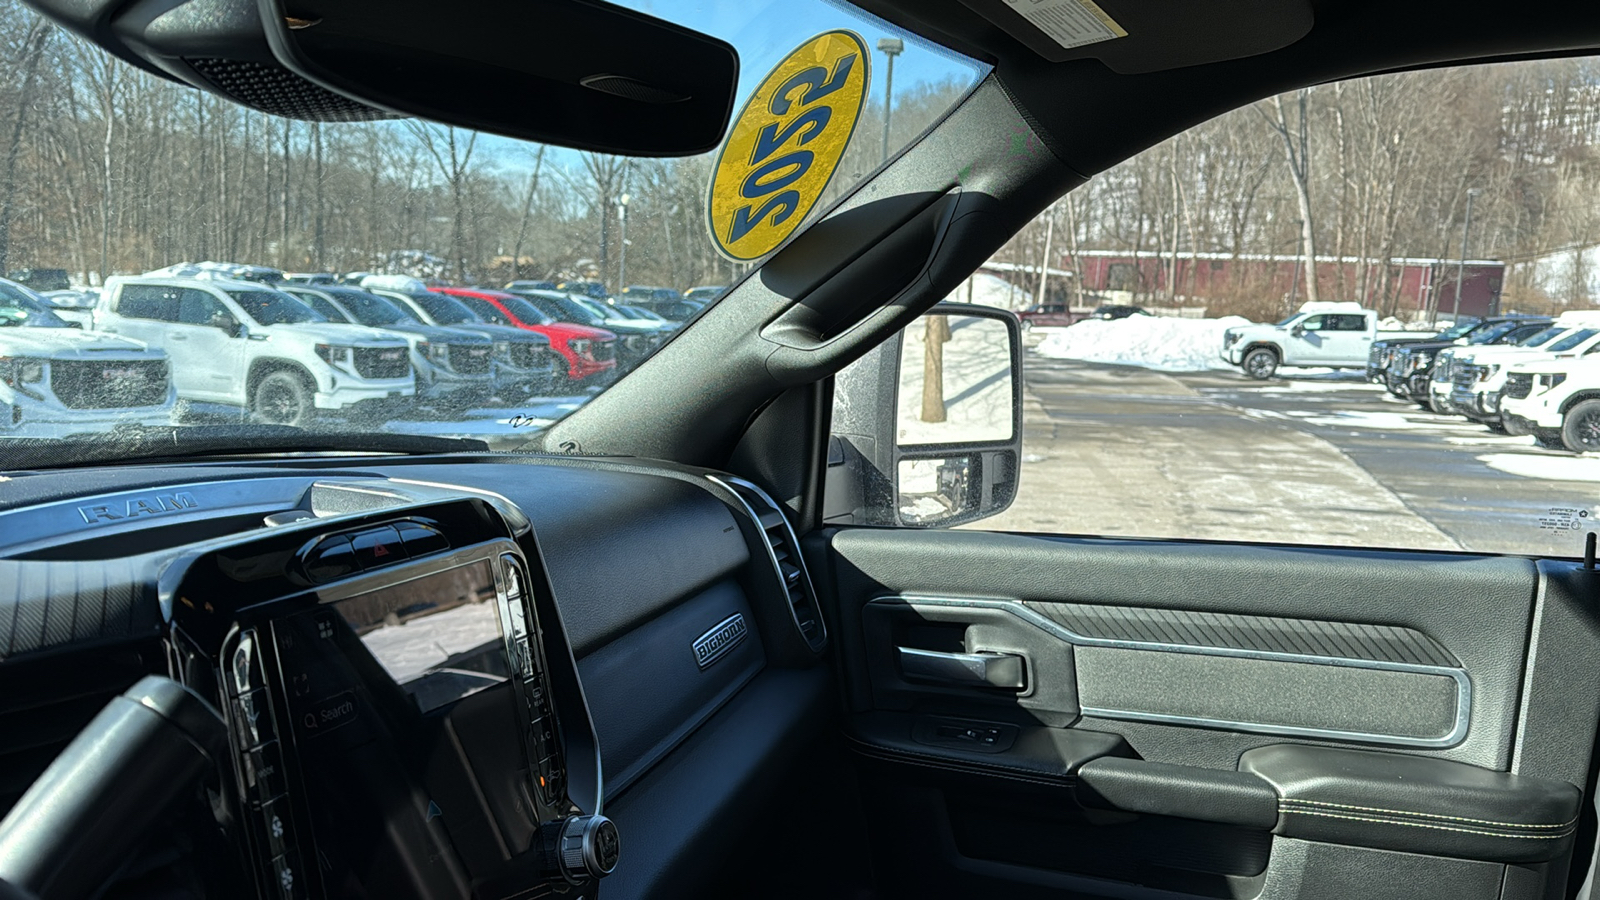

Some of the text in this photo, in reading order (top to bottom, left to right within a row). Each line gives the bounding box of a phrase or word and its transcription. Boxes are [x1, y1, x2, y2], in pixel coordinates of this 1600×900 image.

[77, 491, 199, 524] RAM
[696, 618, 745, 660] BIGHORN
[320, 700, 354, 723] Search
